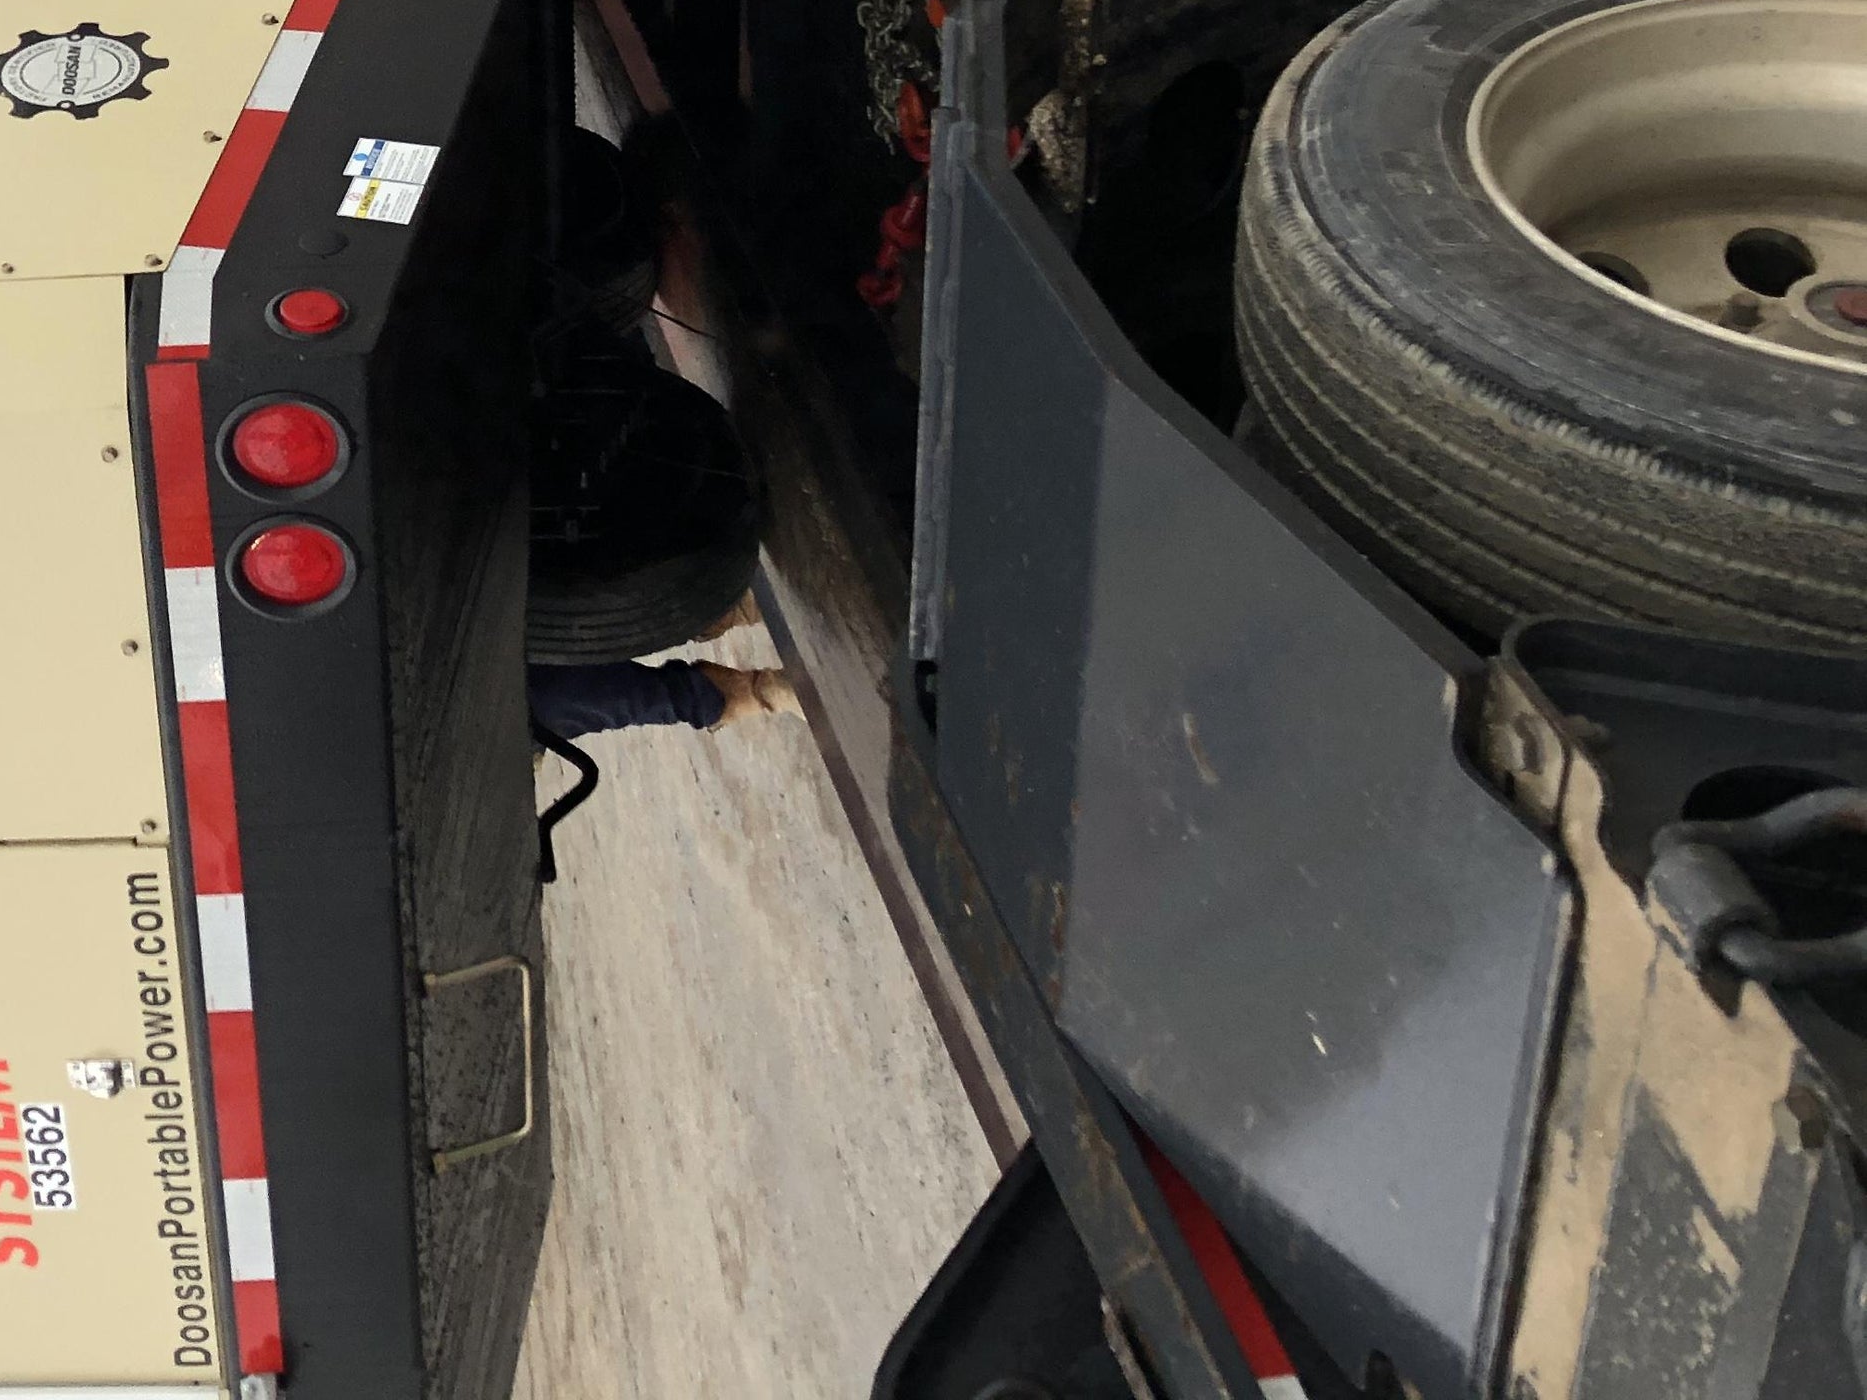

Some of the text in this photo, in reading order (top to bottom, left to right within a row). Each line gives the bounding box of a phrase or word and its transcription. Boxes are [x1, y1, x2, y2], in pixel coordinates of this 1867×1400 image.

[61, 45, 82, 95] DOOSAN
[23, 1105, 73, 1209] 53562
[125, 872, 213, 1368] DoosanPortablePower.com
